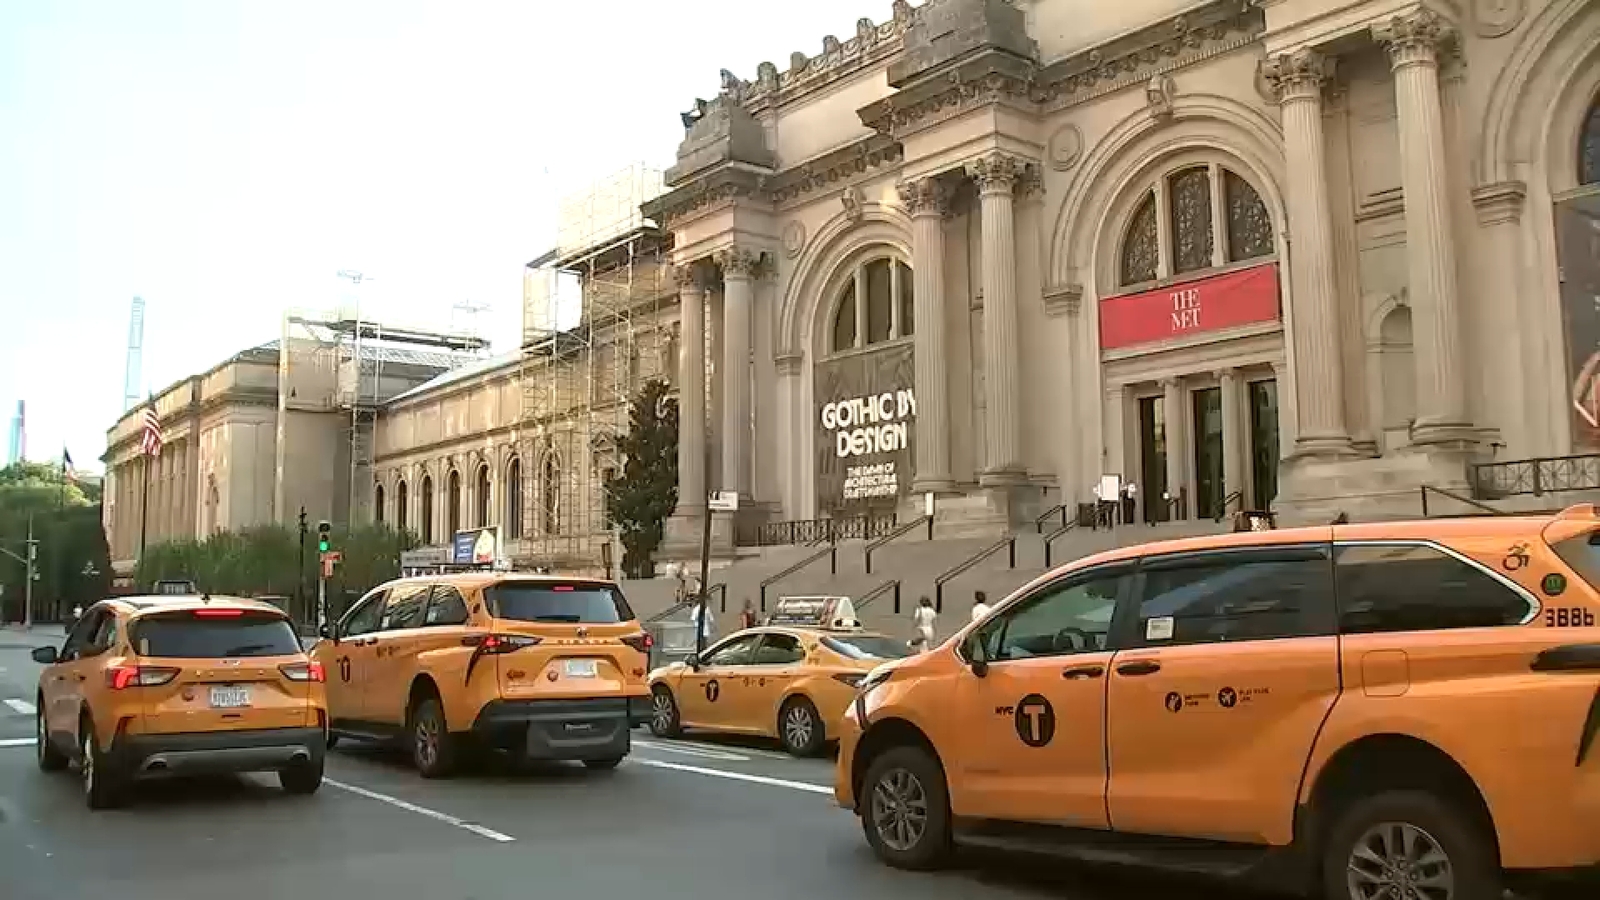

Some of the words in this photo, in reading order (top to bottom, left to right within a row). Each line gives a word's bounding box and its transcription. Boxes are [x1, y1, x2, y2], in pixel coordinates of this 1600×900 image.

[1170, 289, 1201, 310] THE
[1171, 308, 1201, 331] MET
[822, 392, 894, 429] GOTHIC
[836, 421, 907, 458] DESIGN
[995, 706, 1014, 715] NYC
